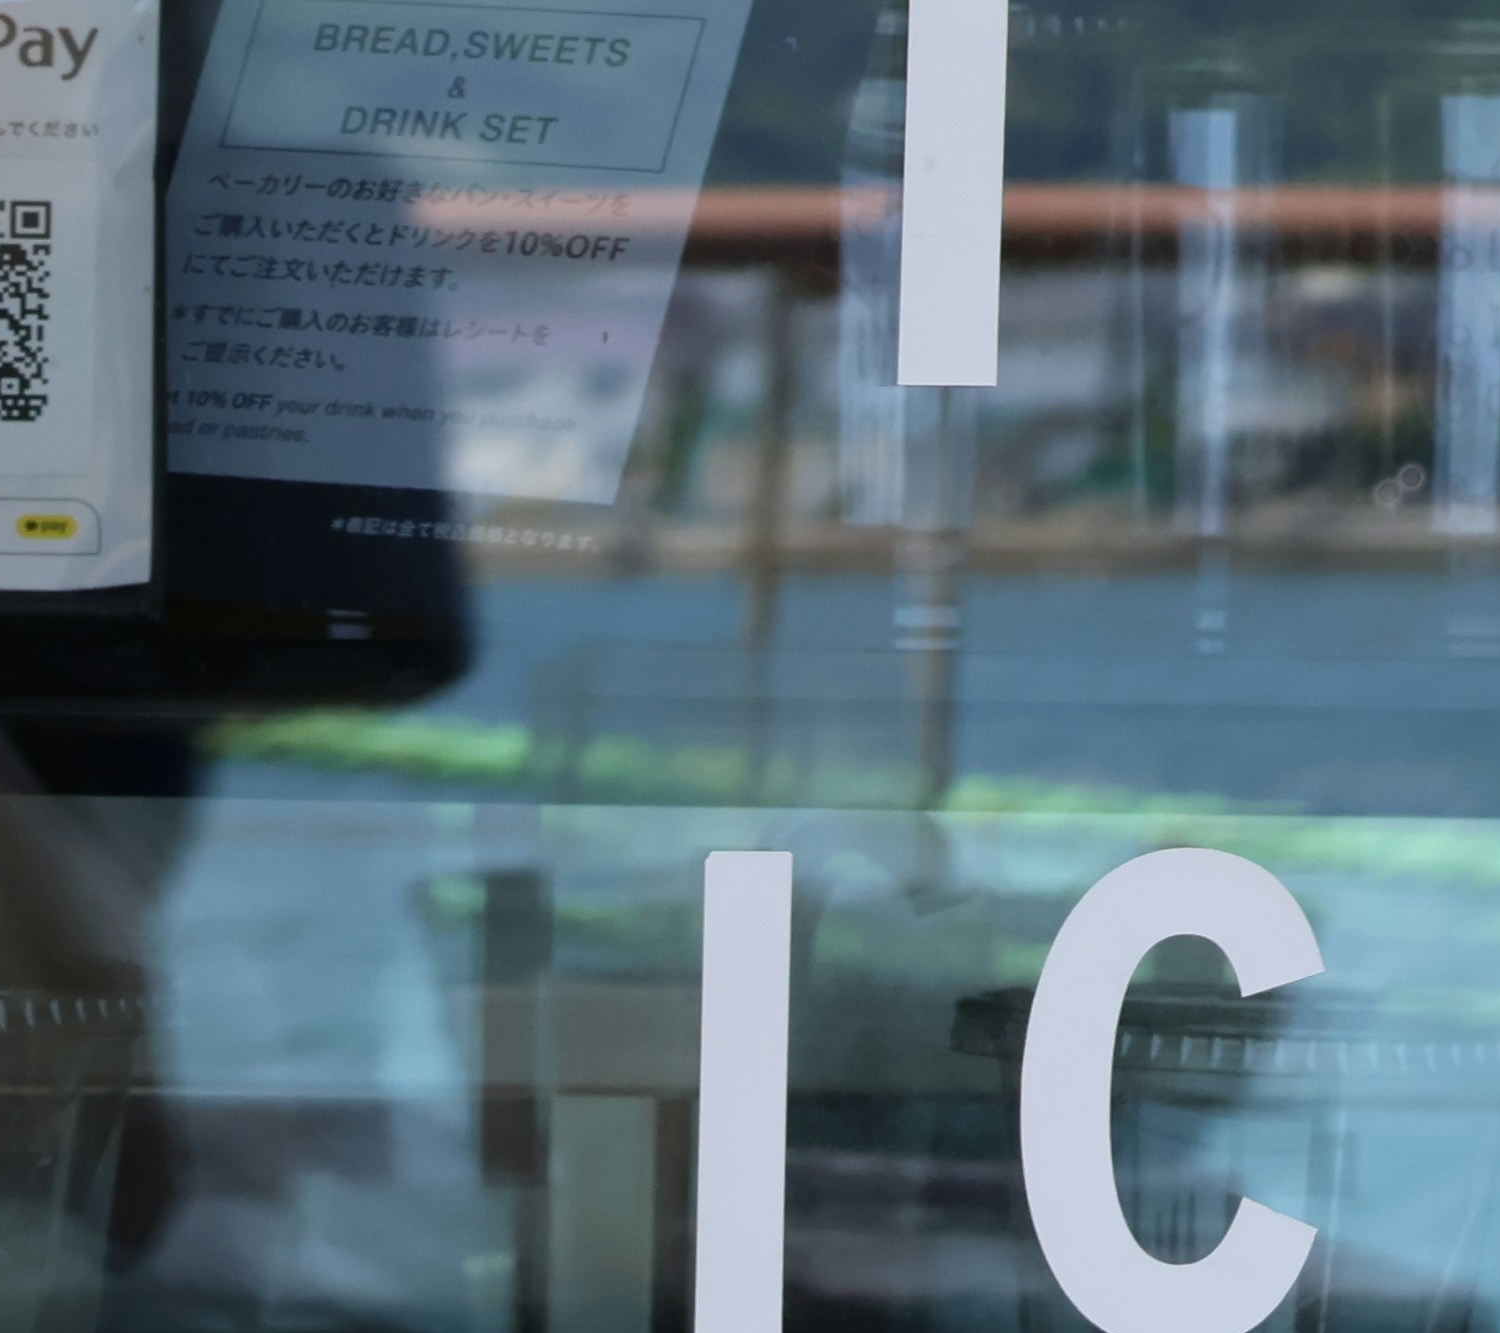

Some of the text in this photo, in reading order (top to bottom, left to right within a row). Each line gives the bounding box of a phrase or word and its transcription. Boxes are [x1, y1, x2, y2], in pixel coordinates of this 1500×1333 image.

[448, 76, 467, 99] &
[340, 106, 559, 146] DRINK SET
[232, 392, 272, 410] OFF
[323, 400, 375, 418] drink
